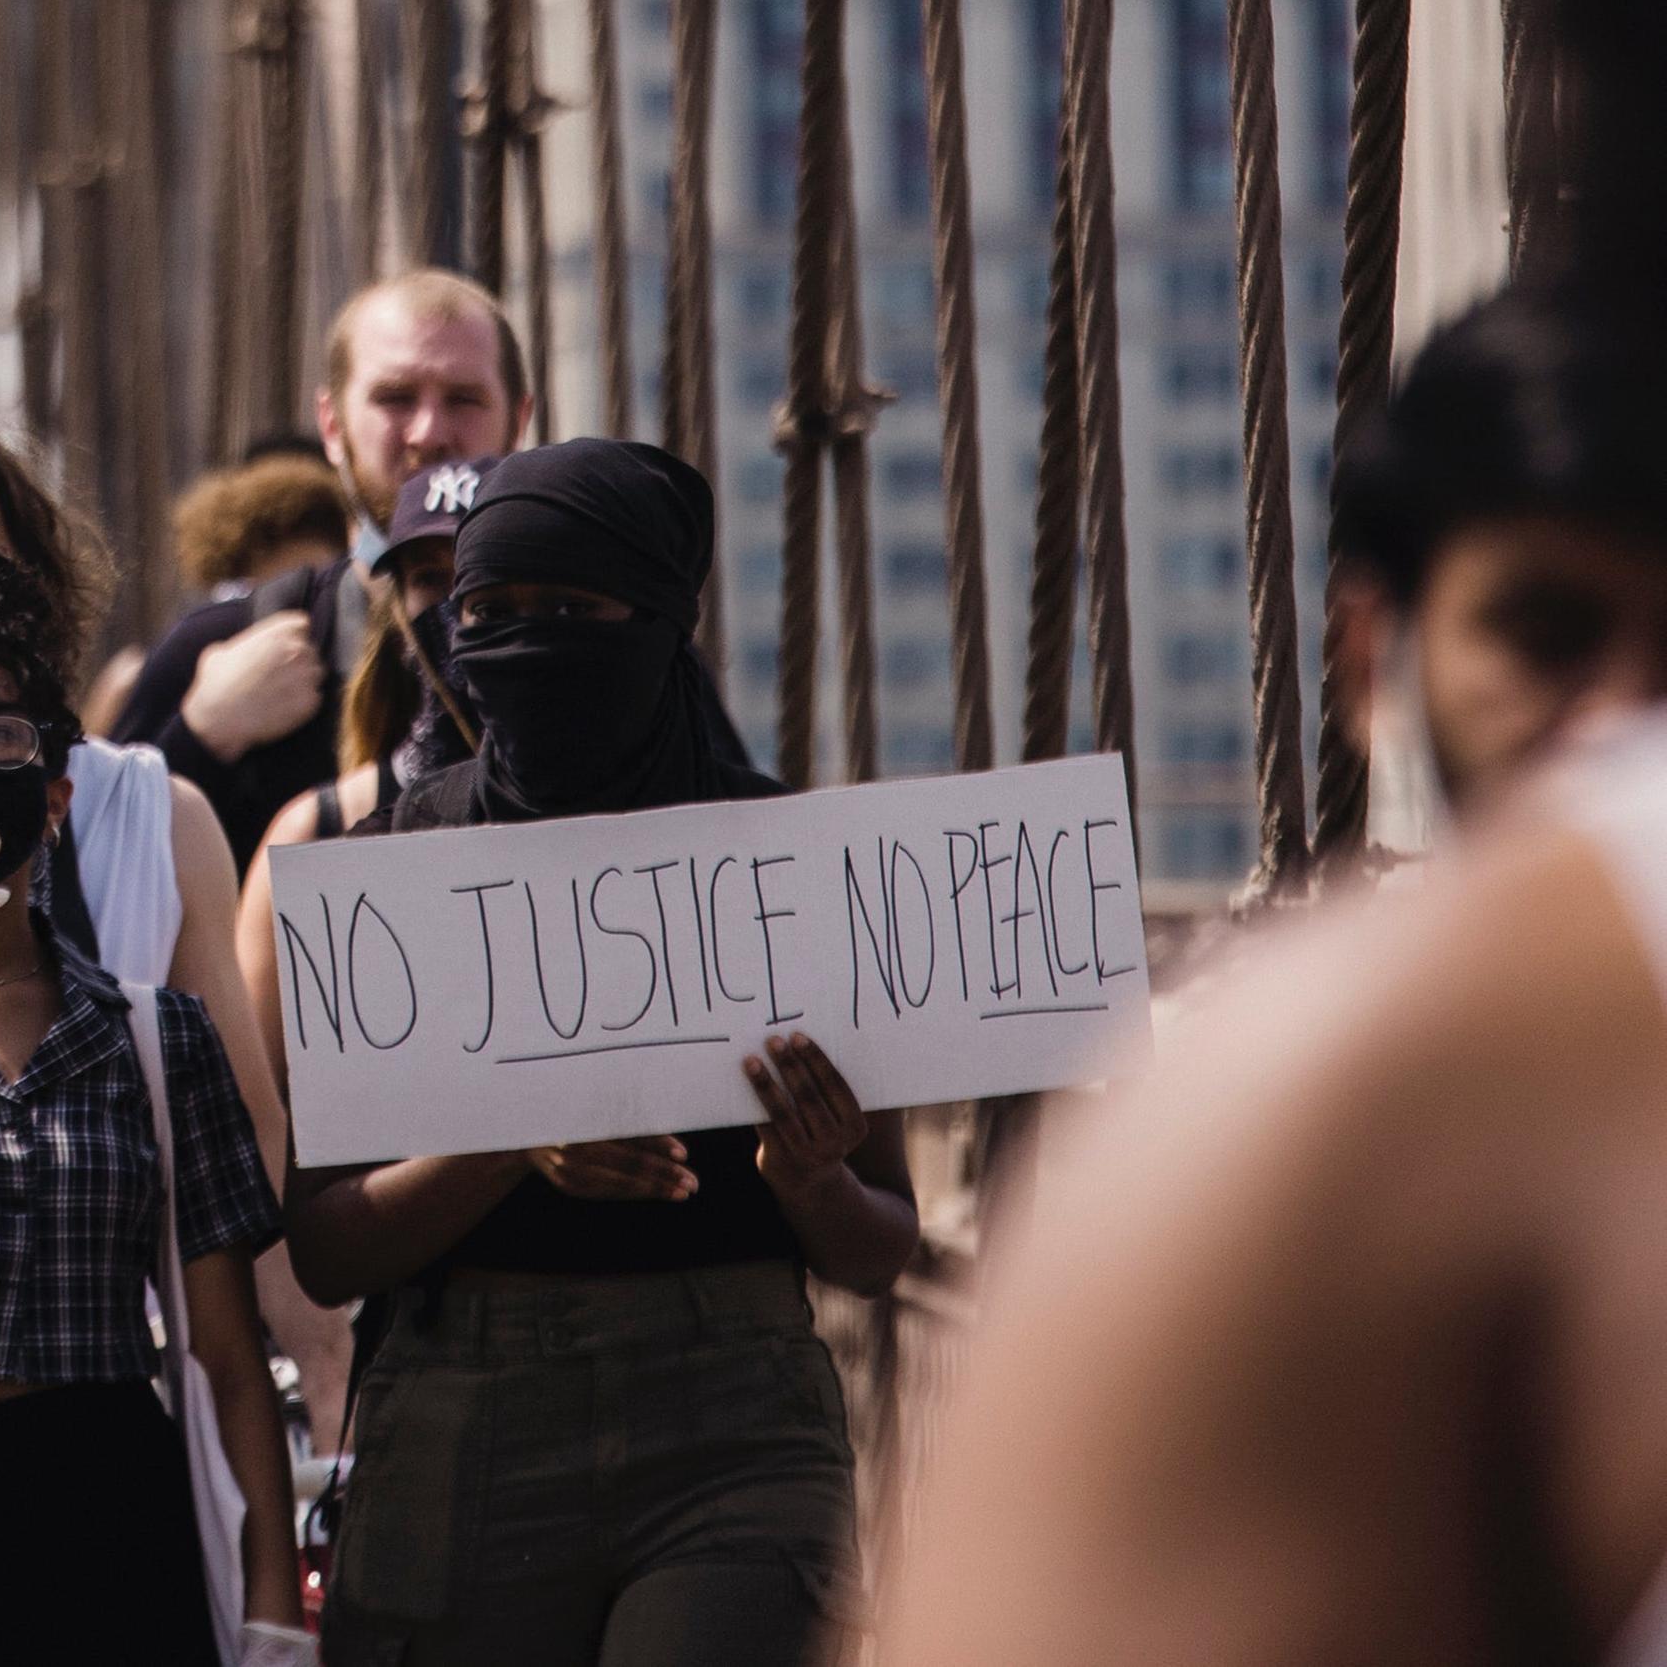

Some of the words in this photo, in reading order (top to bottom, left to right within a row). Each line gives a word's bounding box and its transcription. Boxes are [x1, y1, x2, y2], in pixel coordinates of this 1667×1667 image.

[279, 891, 417, 1053] NO
[450, 856, 803, 1054] JUSTICE
[844, 834, 935, 1031] NO
[943, 820, 1138, 1003] PEACE
